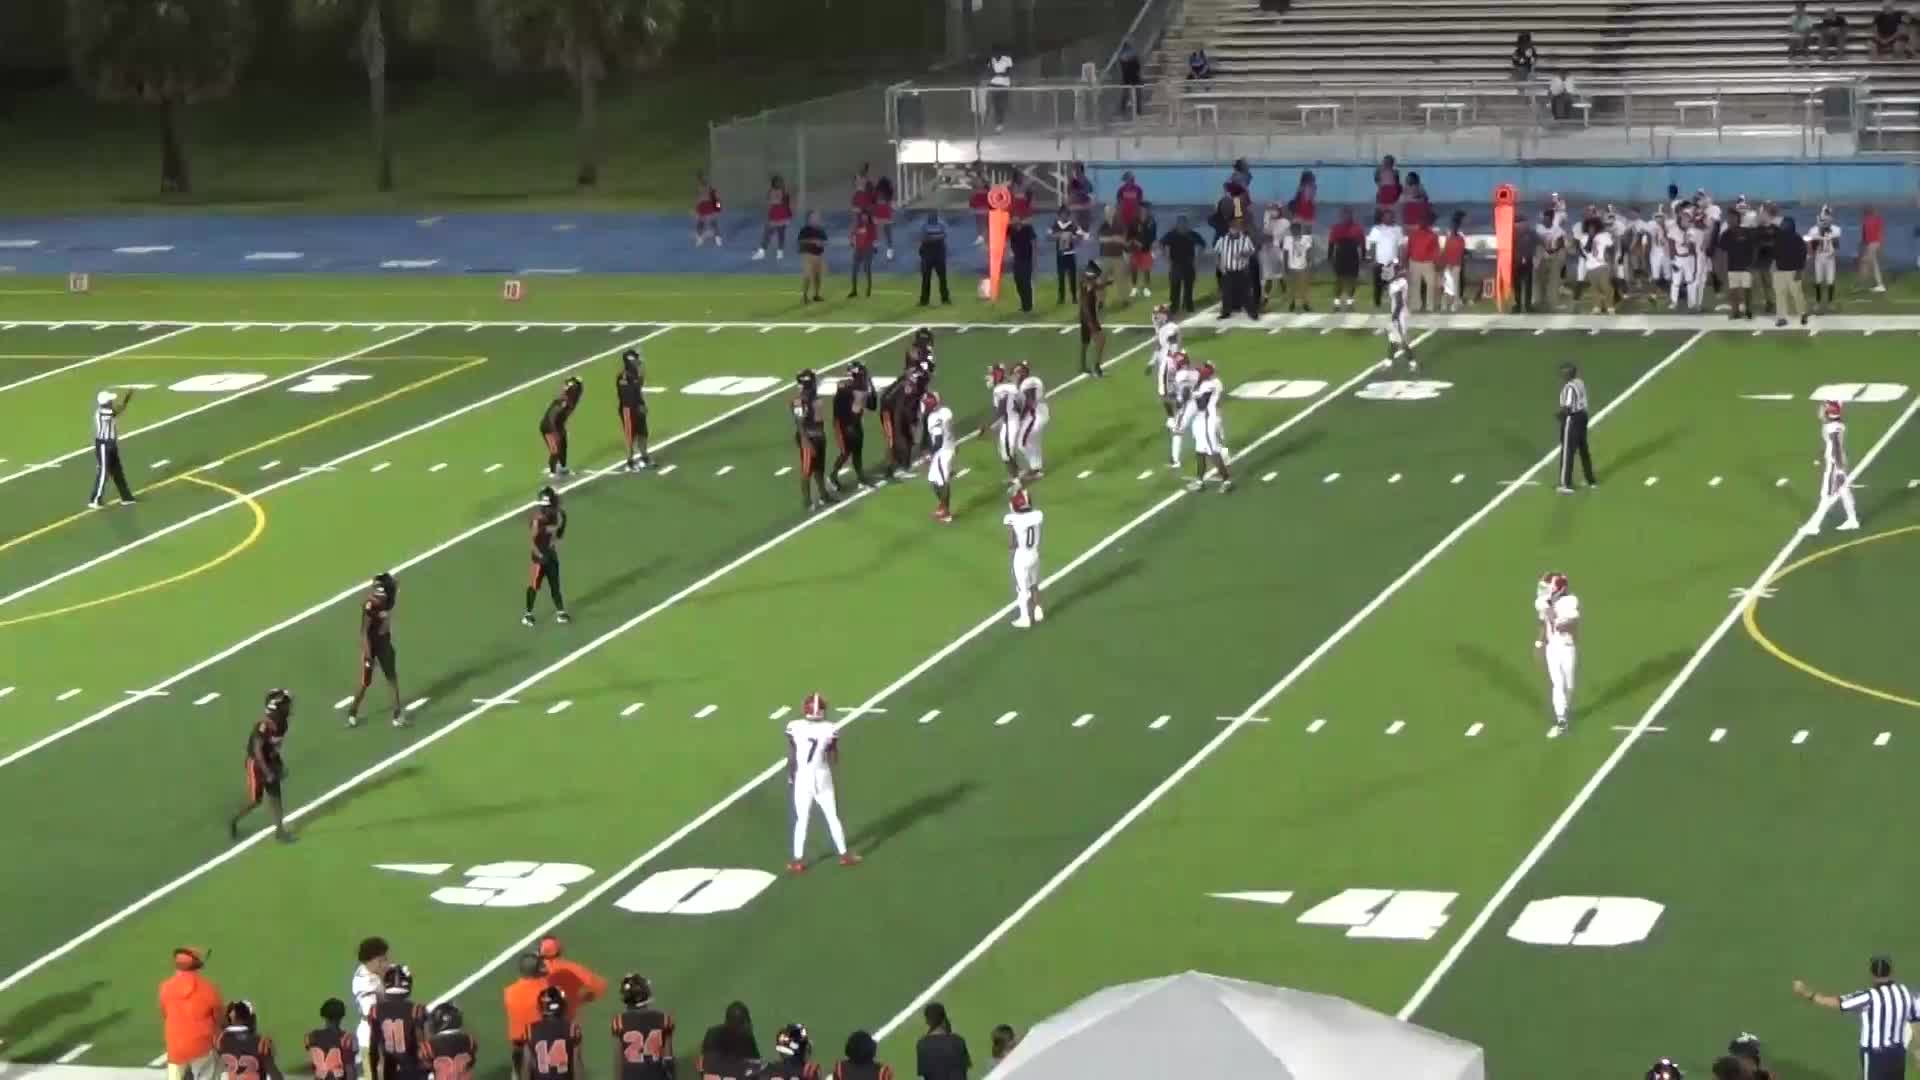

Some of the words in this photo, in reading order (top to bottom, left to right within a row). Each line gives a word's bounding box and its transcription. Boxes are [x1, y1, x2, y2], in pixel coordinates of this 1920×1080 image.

[1026, 525, 1036, 549] 0
[807, 737, 819, 764] 7
[381, 1018, 406, 1053] 11
[623, 1029, 664, 1062] 24
[535, 1039, 568, 1073] 14
